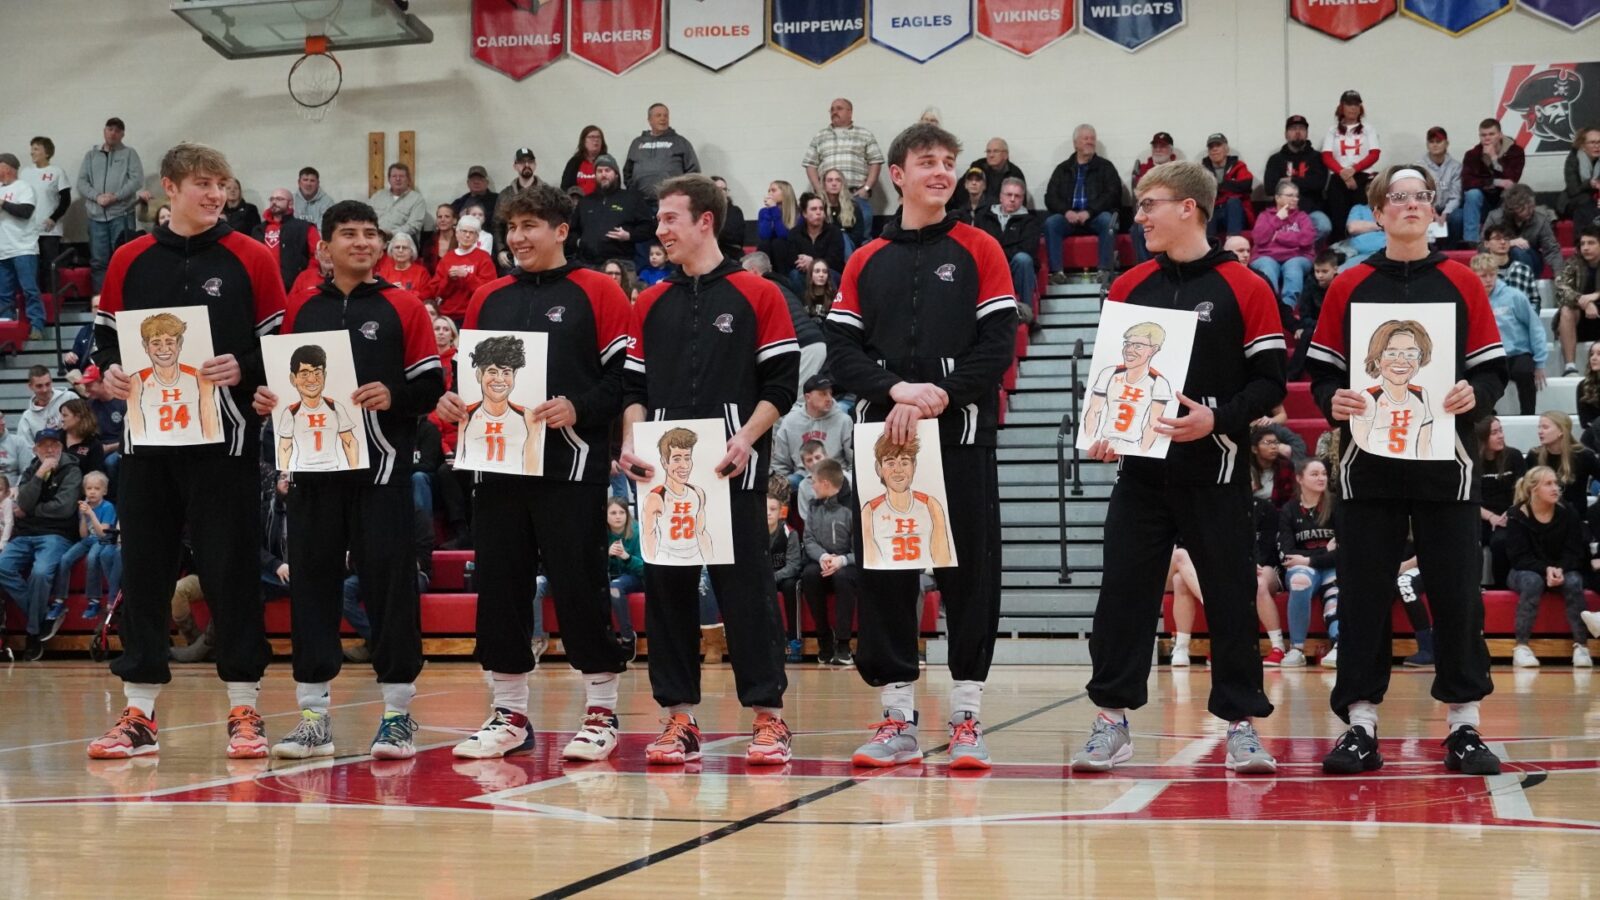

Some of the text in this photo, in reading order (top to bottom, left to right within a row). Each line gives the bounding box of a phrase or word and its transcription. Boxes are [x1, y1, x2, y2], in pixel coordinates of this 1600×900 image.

[993, 8, 1061, 24] VIKINGS
[1091, 2, 1174, 18] WILDCATS
[773, 18, 864, 34] CHIPPEWAS
[891, 15, 952, 28] EAGLES
[583, 29, 652, 44] PACKERS
[683, 24, 750, 38] ORIOLES
[476, 33, 561, 48] CARDINALS
[1339, 139, 1362, 156] H
[162, 389, 182, 402] H
[1119, 384, 1144, 402] H
[159, 404, 191, 432] 24
[307, 413, 326, 428] H
[1114, 403, 1136, 432] 3
[1390, 409, 1412, 427] H
[485, 422, 504, 435] H
[313, 431, 323, 452] 1
[486, 436, 506, 462] 11
[672, 502, 692, 513] H
[670, 515, 695, 540] 22
[895, 518, 917, 534] H
[1296, 528, 1335, 541] PIRATES
[892, 536, 921, 561] 35
